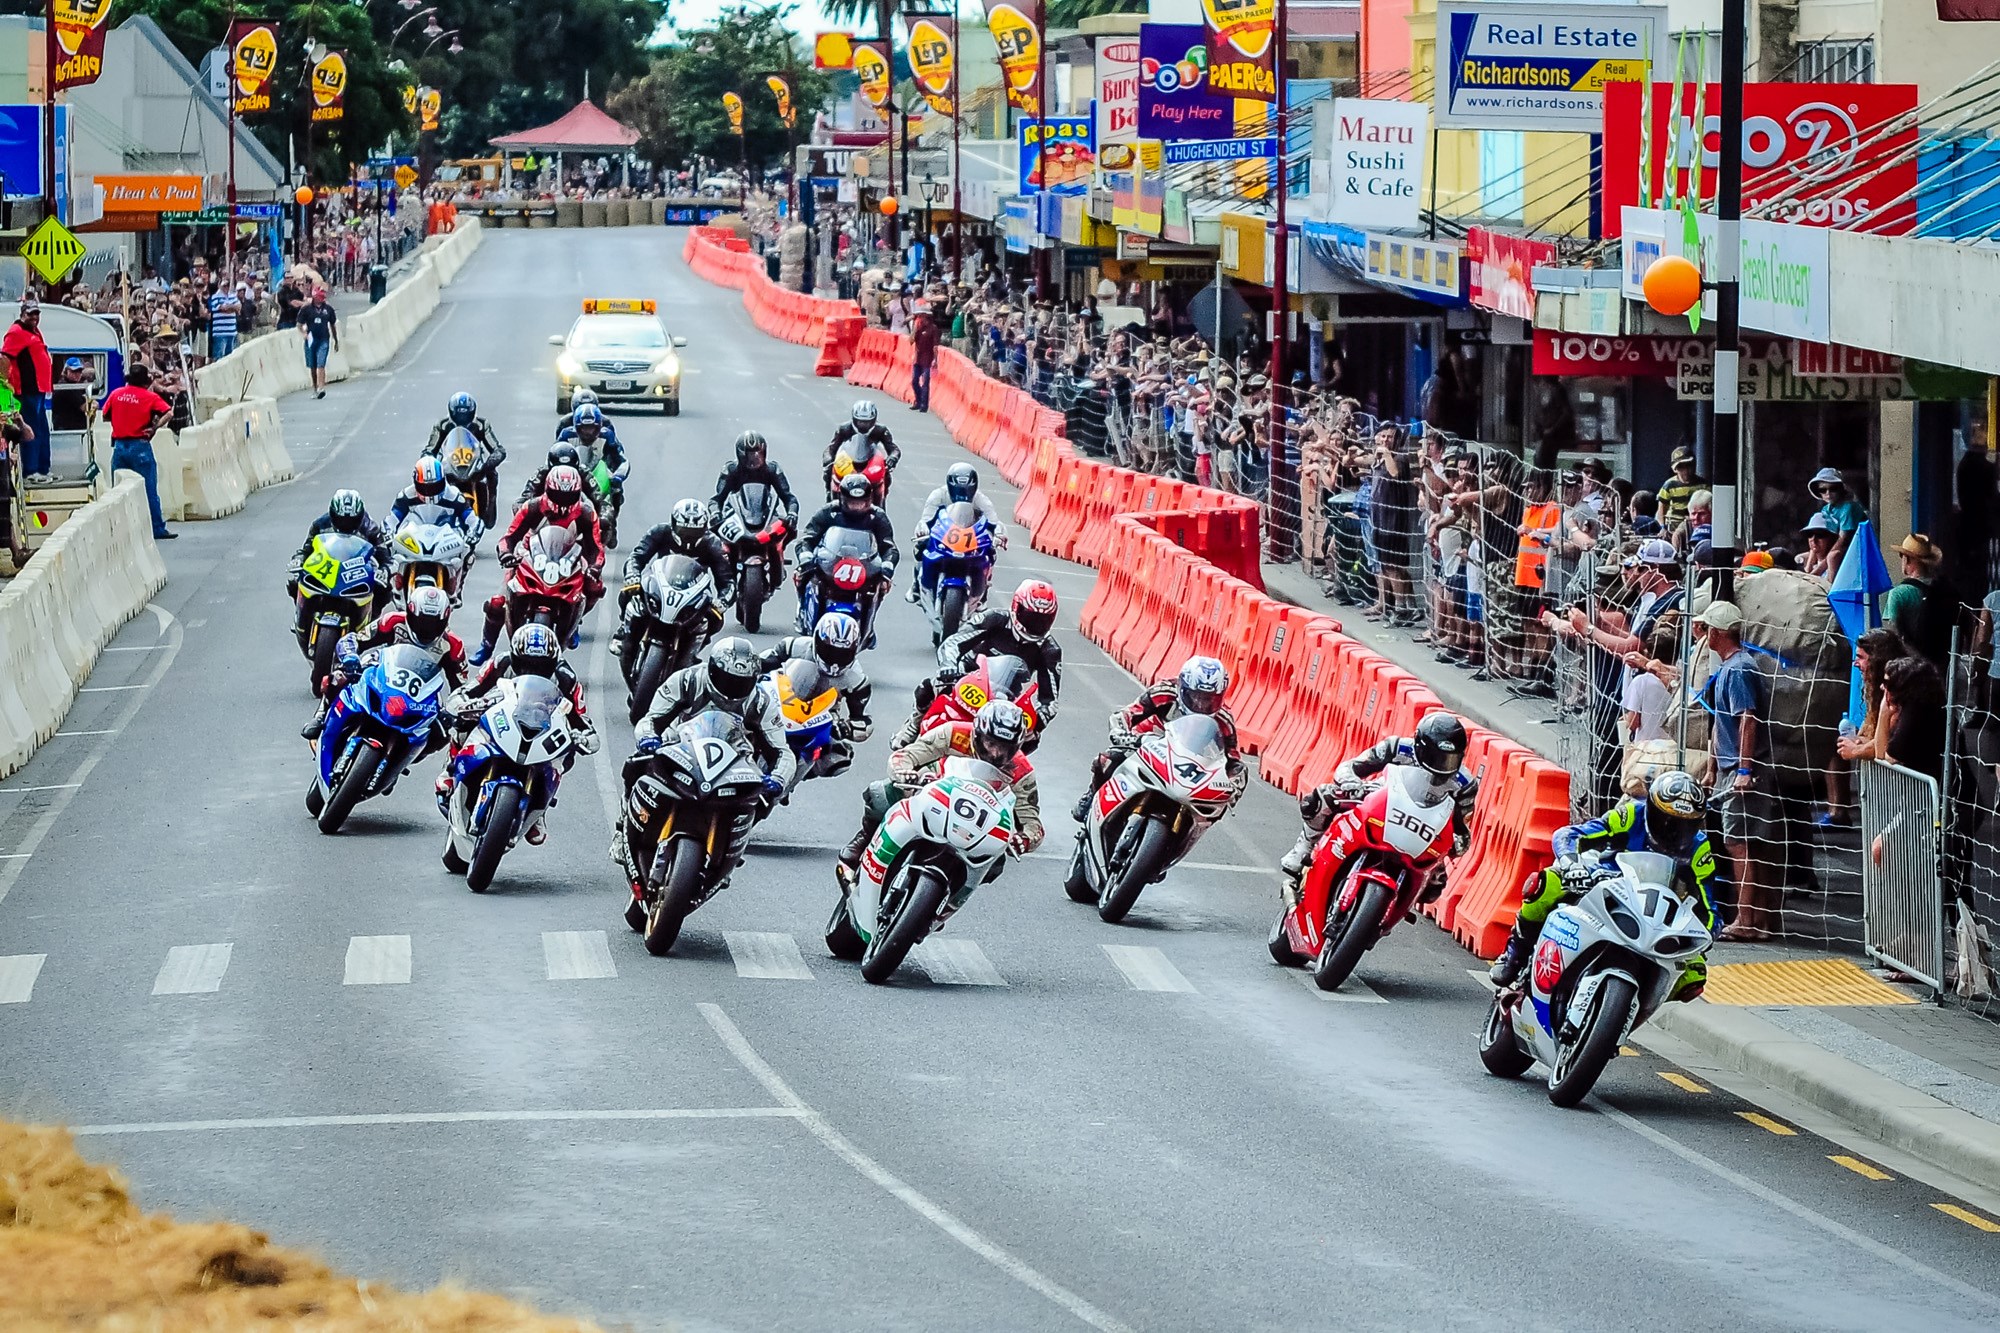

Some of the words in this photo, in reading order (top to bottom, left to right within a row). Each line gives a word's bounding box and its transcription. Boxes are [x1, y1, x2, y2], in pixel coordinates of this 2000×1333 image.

[1488, 24, 1543, 45] Real
[1554, 26, 1638, 48] Estate
[1209, 62, 1275, 94] PAEROA
[1463, 60, 1571, 87] Richardsons
[1604, 63, 1628, 75] Real
[1151, 103, 1184, 123] Play
[1187, 105, 1223, 120] Here
[1339, 116, 1414, 145] Maru
[1174, 144, 1246, 161] HUGHENDEN
[1251, 141, 1267, 156] ST
[1346, 150, 1405, 172] Sushi
[112, 184, 146, 199] Heat
[149, 184, 161, 199] &
[165, 183, 197, 199] Pool
[1345, 177, 1361, 195] &
[1367, 176, 1414, 198] Cafe
[240, 206, 262, 215] HALL
[1550, 337, 1640, 362] 100%
[1749, 363, 1760, 378] &
[946, 528, 975, 549] 61
[833, 565, 863, 583] 41
[666, 589, 684, 608] 87
[391, 669, 422, 698] 36
[961, 684, 985, 706] 165
[702, 742, 724, 770] D
[1173, 762, 1207, 784] 41
[964, 783, 998, 808] Castrol
[954, 798, 988, 830] 61
[1388, 807, 1435, 843] 366
